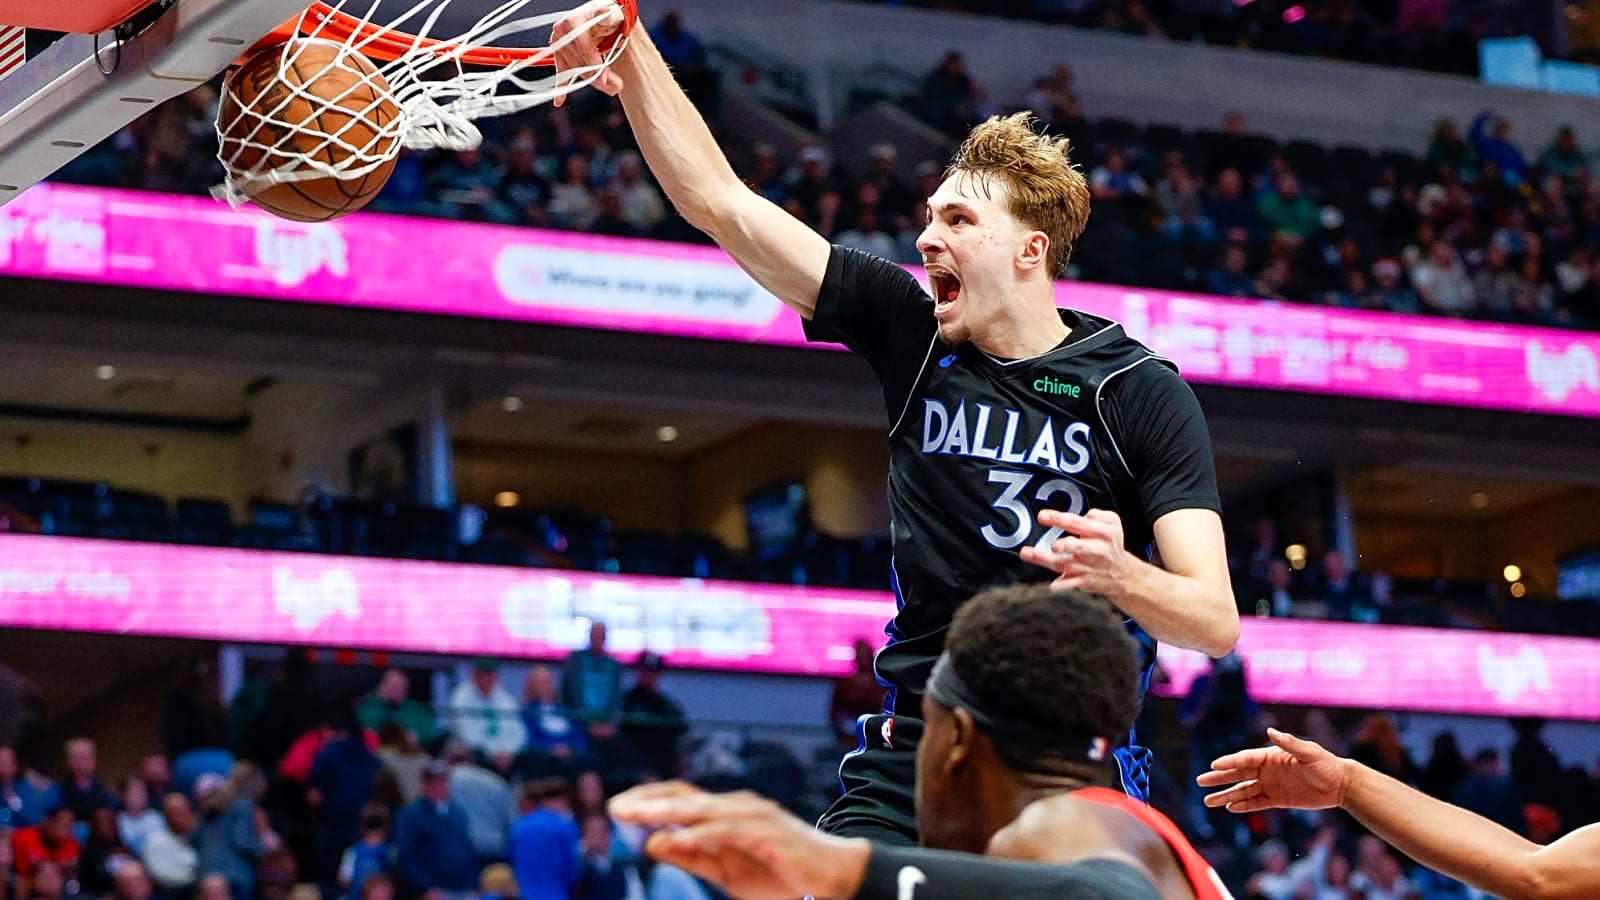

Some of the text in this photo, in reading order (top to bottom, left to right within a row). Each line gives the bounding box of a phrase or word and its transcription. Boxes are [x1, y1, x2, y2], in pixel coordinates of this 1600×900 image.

[257, 217, 347, 286] lyft
[548, 267, 609, 291] Where
[616, 278, 648, 294] are
[654, 280, 687, 300] you
[1033, 376, 1081, 398] chime
[921, 397, 1092, 475] DALLAS
[979, 468, 1085, 558] 32
